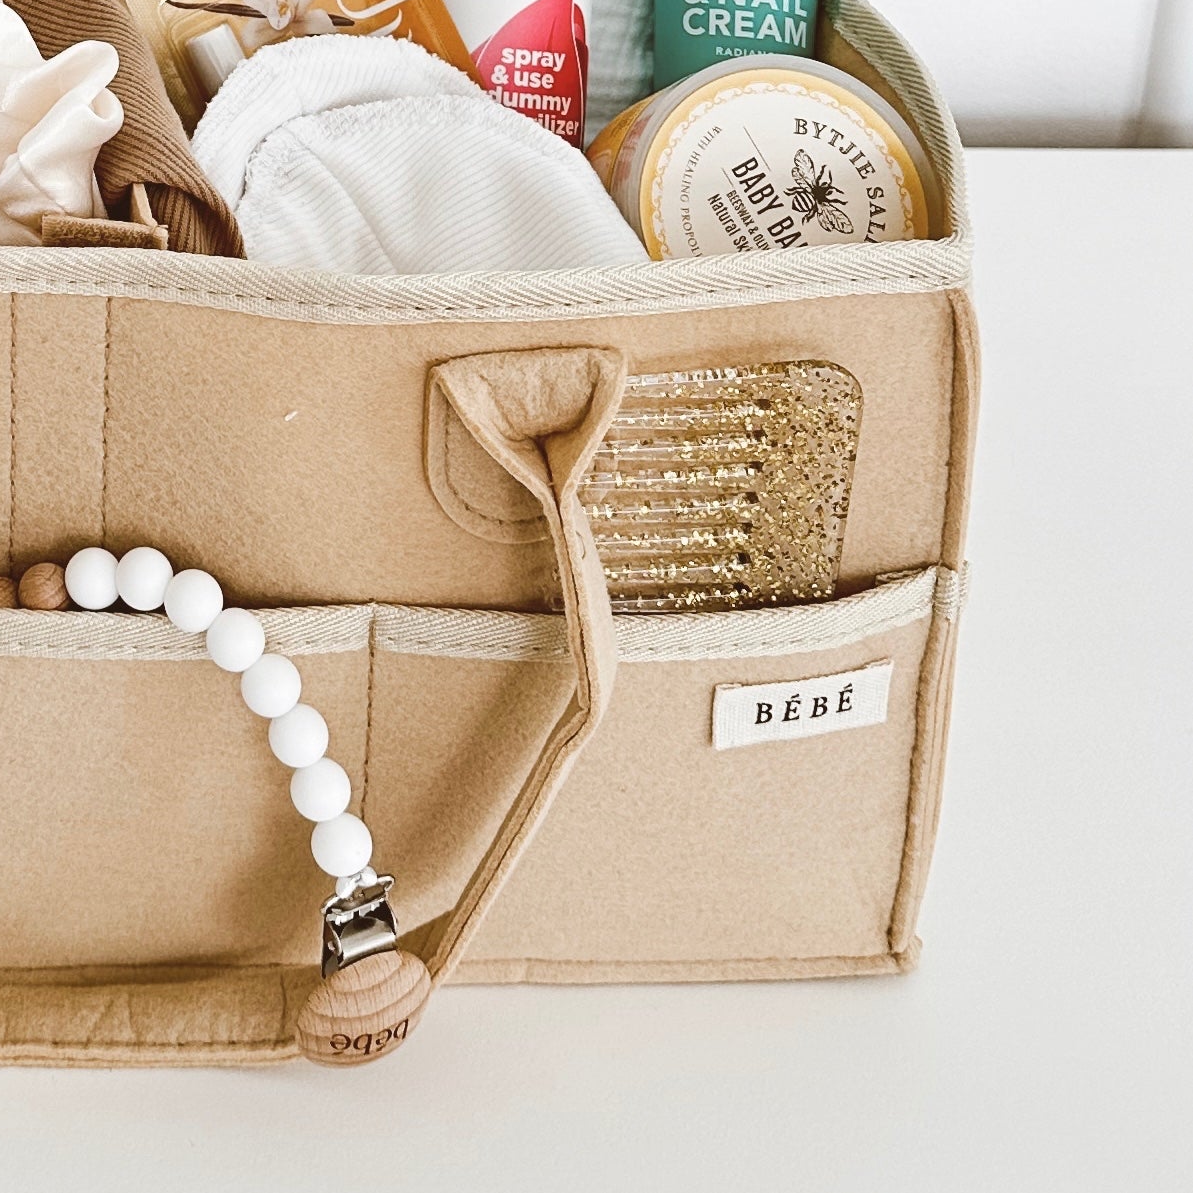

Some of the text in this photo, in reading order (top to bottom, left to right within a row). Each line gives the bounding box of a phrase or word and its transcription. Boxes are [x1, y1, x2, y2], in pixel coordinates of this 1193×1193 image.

[682, 7, 808, 49] CREAM
[501, 47, 566, 72] spray
[715, 46, 775, 57] RADIAN
[490, 64, 555, 89] & use
[487, 86, 572, 116] dummy
[536, 113, 579, 136] ilizer
[793, 117, 877, 181] BYTJIE
[730, 156, 786, 217] BABY
[680, 207, 703, 258] PROPOLI
[707, 193, 742, 237] Natural
[726, 189, 755, 228] BEESWAX
[752, 233, 771, 251] OLIV
[754, 682, 854, 725] BÉBÉ
[329, 1017, 410, 1056] bébé
